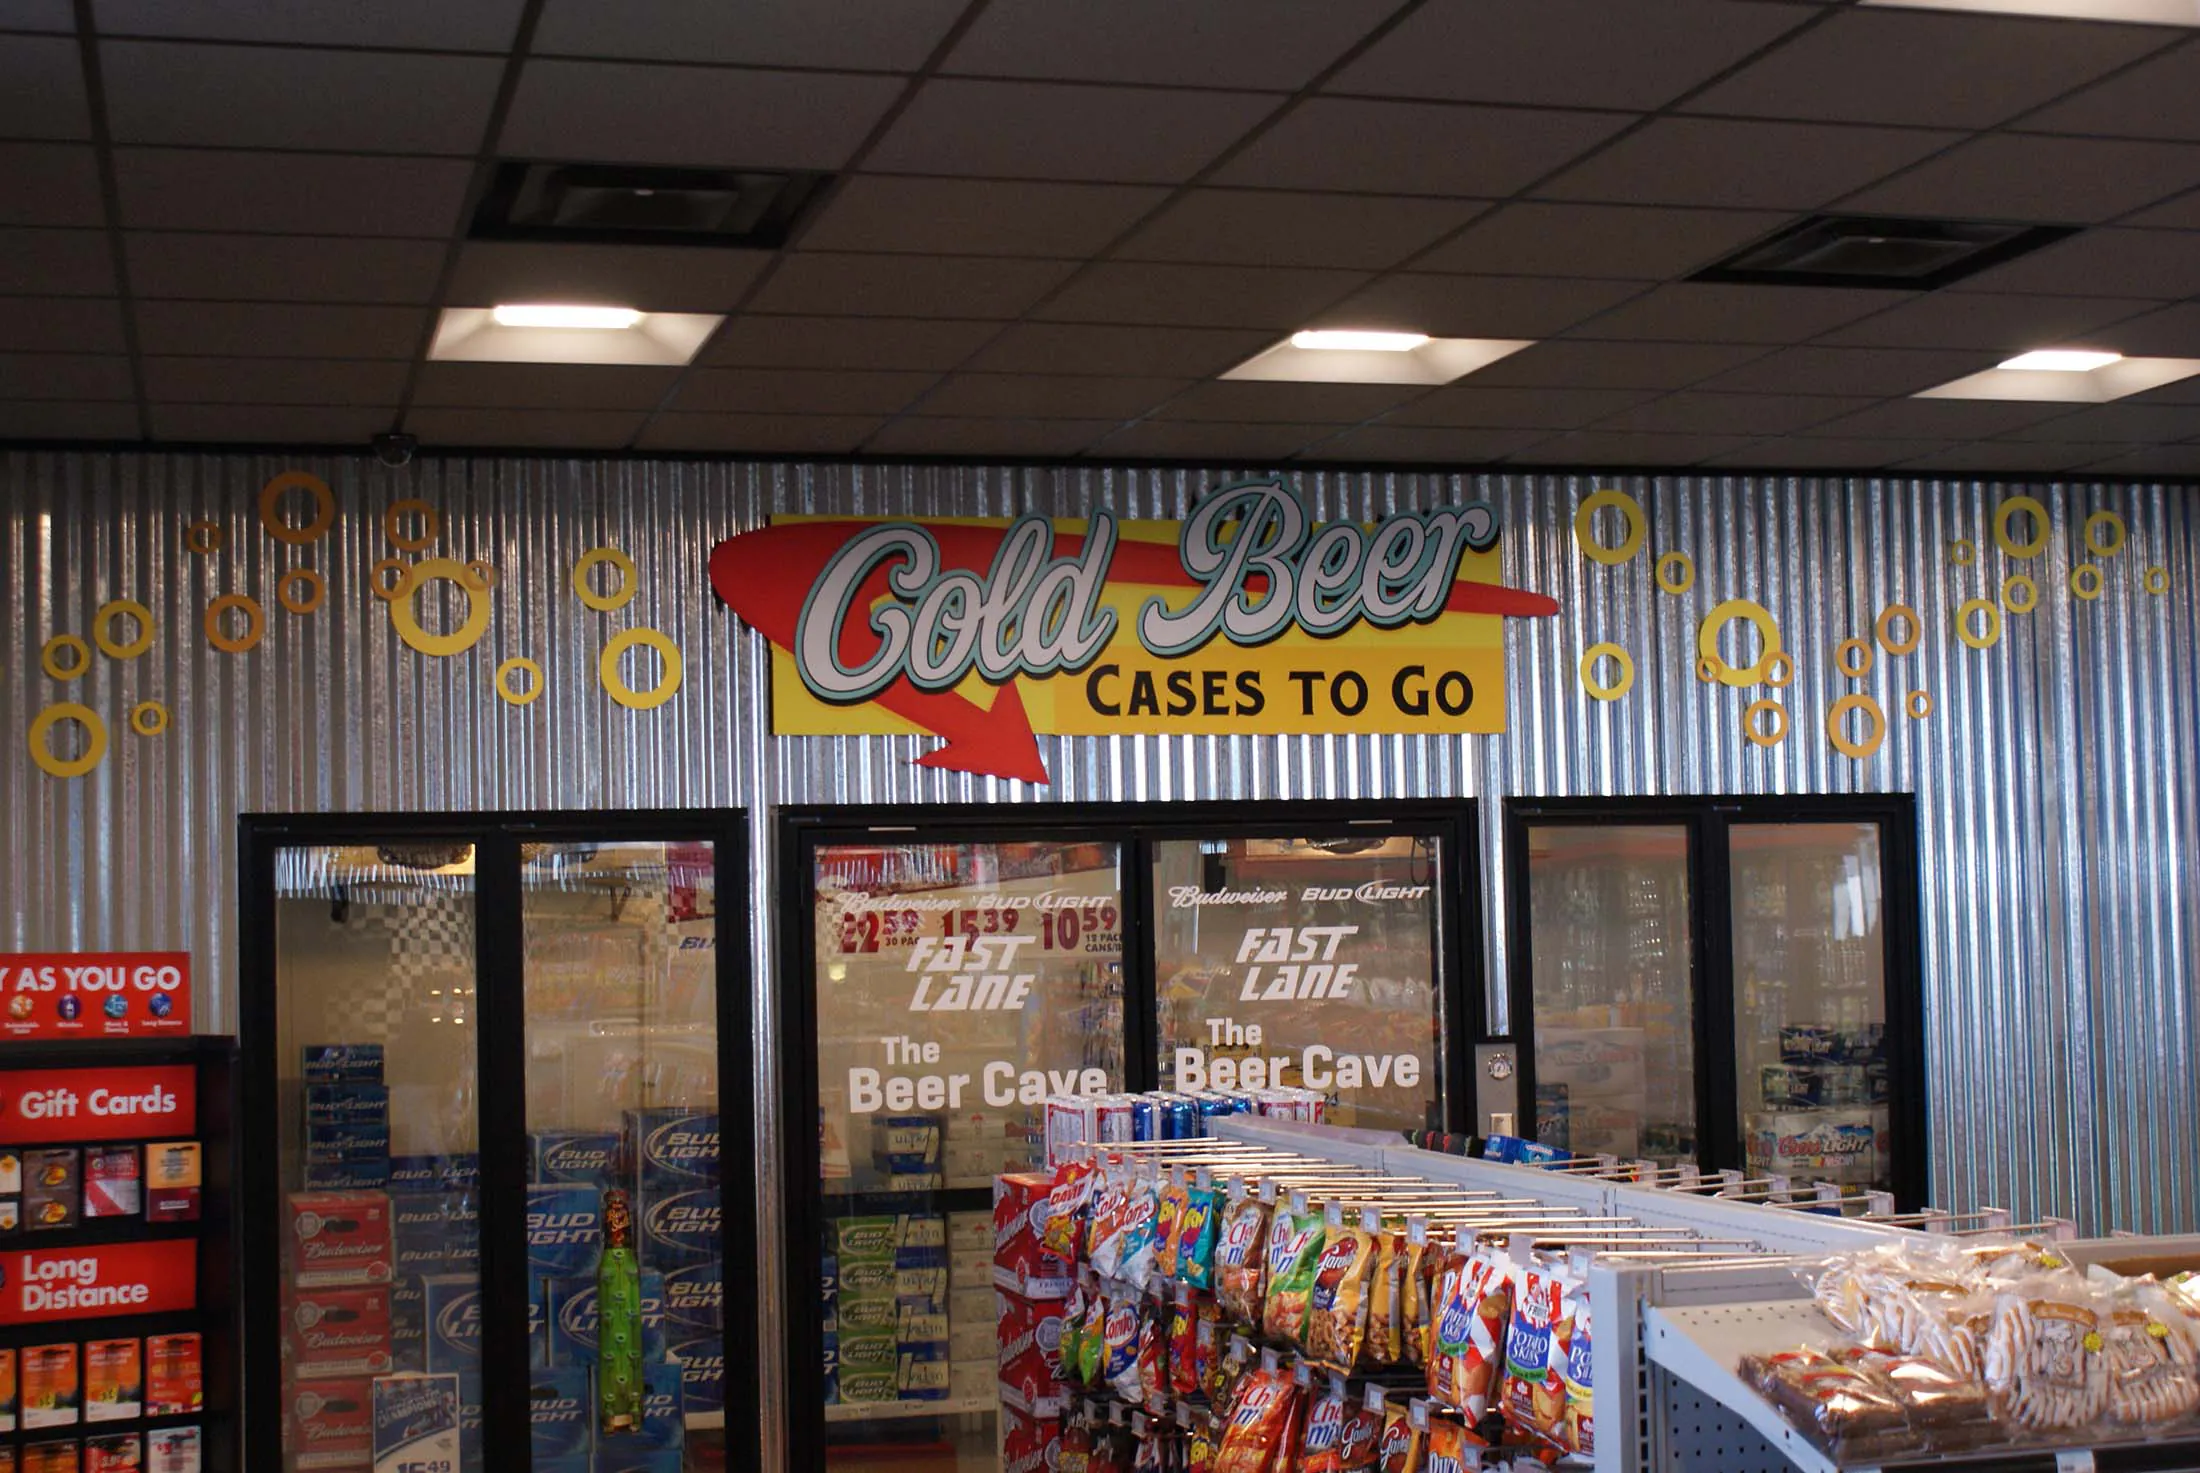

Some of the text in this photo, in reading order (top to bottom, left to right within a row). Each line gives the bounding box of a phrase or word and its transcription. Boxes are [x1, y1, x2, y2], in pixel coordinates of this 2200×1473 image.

[800, 480, 1494, 700] Cold Beer
[1086, 669, 1266, 717] CASES
[1289, 672, 1368, 717] TO
[836, 891, 1113, 914] Budweiser BUD LIGHT
[1168, 886, 1431, 908] Budweiser BUD LIGHT
[901, 937, 920, 947] PAC
[1101, 934, 1123, 944] PAC
[1235, 926, 1360, 962] FAST
[905, 935, 1036, 972] FAST
[16, 966, 56, 991] AS
[63, 966, 126, 991] YOU
[133, 965, 181, 991] GO
[1206, 1017, 1262, 1047] The
[880, 1035, 941, 1065] The
[1175, 1044, 1420, 1093] Beer Cave
[848, 1060, 1108, 1114] Beer Cave
[20, 1084, 176, 1119] Gift Cards
[558, 1150, 606, 1160] BUD
[655, 1145, 721, 1159] LIGH
[1822, 1136, 1870, 1154] LIGHT
[550, 1159, 609, 1169] LIGHT
[398, 1212, 441, 1223] BUD
[655, 1220, 721, 1233] LIGH
[303, 1240, 384, 1259] Budweiser
[400, 1252, 443, 1262] BUD
[22, 1254, 98, 1284] Long
[22, 1281, 149, 1312] Distance
[393, 1289, 422, 1300] BU
[303, 1330, 385, 1348] Budweiser
[393, 1329, 422, 1339] BU
